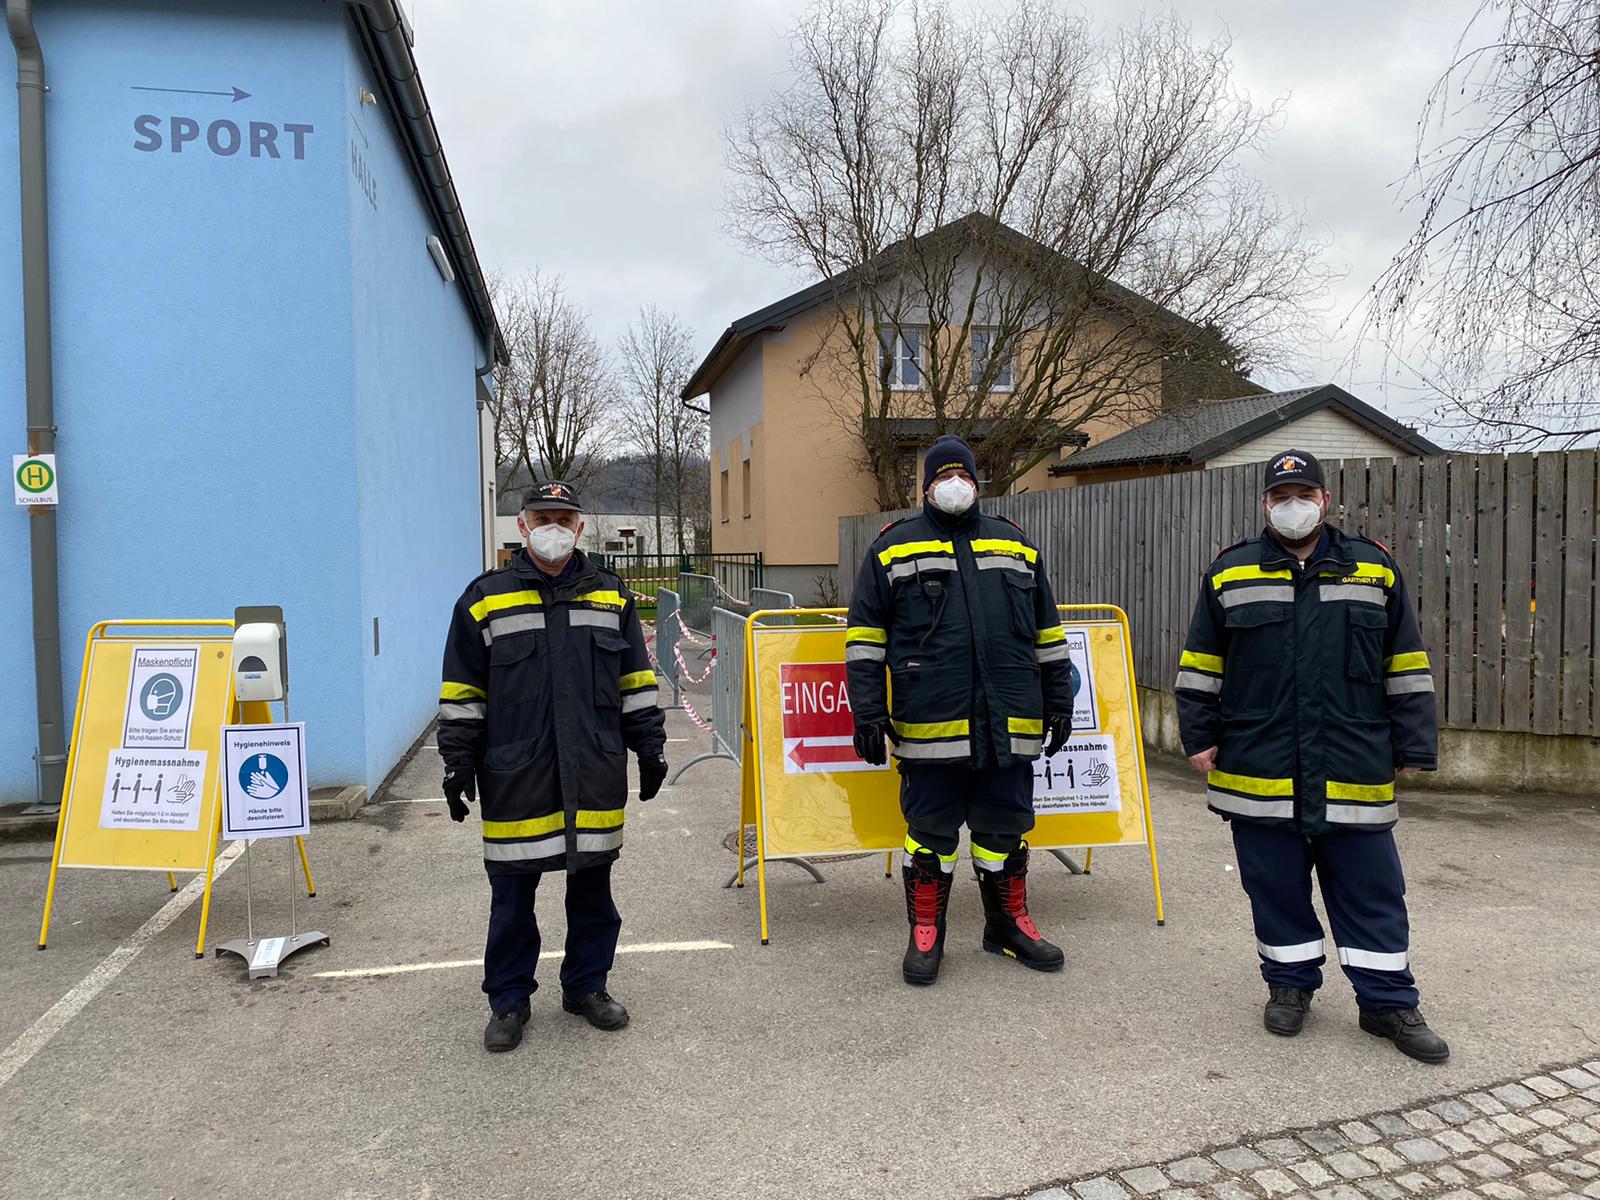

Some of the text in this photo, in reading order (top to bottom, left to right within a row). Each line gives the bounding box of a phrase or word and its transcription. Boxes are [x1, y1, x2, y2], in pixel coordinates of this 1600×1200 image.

[133, 114, 314, 160] SPORT
[351, 139, 377, 212] HALLE
[27, 467, 44, 486] H
[138, 657, 192, 667] Maskenpflicht
[781, 681, 852, 714] EINGA
[141, 727, 158, 735] tragen
[233, 740, 291, 749] Hygienehinweis
[114, 756, 200, 768] Hygienemassnahme
[246, 813, 285, 821] desinfizieren
